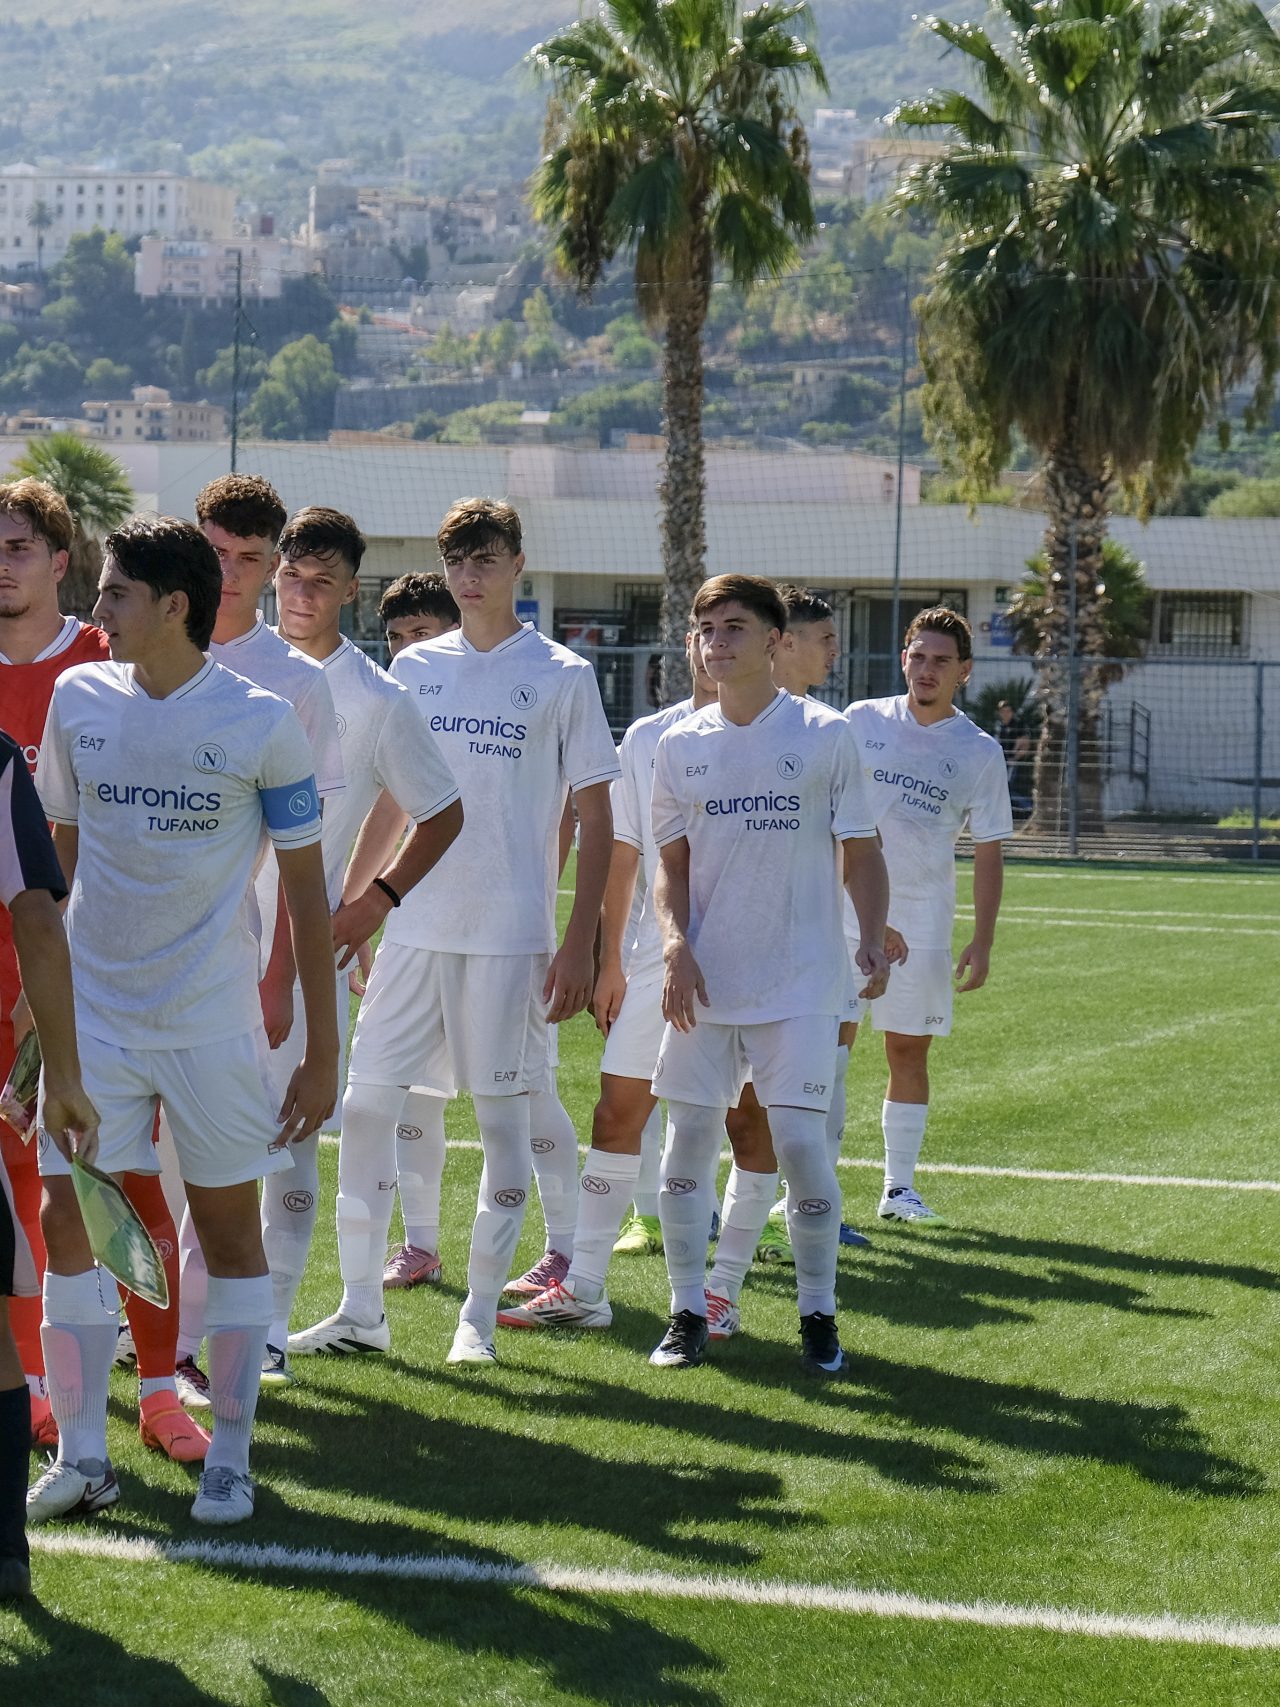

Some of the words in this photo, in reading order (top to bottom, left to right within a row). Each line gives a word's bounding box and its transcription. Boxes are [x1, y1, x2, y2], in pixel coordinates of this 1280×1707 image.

[419, 685, 444, 695] EA7
[430, 715, 527, 741] euronics
[80, 736, 106, 751] EA7
[468, 741, 522, 759] TUFANO
[865, 739, 886, 751] EA7
[686, 765, 709, 777] EA7
[873, 769, 950, 801] euronics
[97, 783, 221, 811] euronics
[705, 791, 801, 816] euronics
[901, 793, 942, 815] TUFANO
[147, 816, 219, 832] TUFANO
[745, 819, 800, 831] TUFANO
[925, 1016, 944, 1025] EA7
[494, 1071, 518, 1082] EA7
[803, 1082, 827, 1096] EA7
